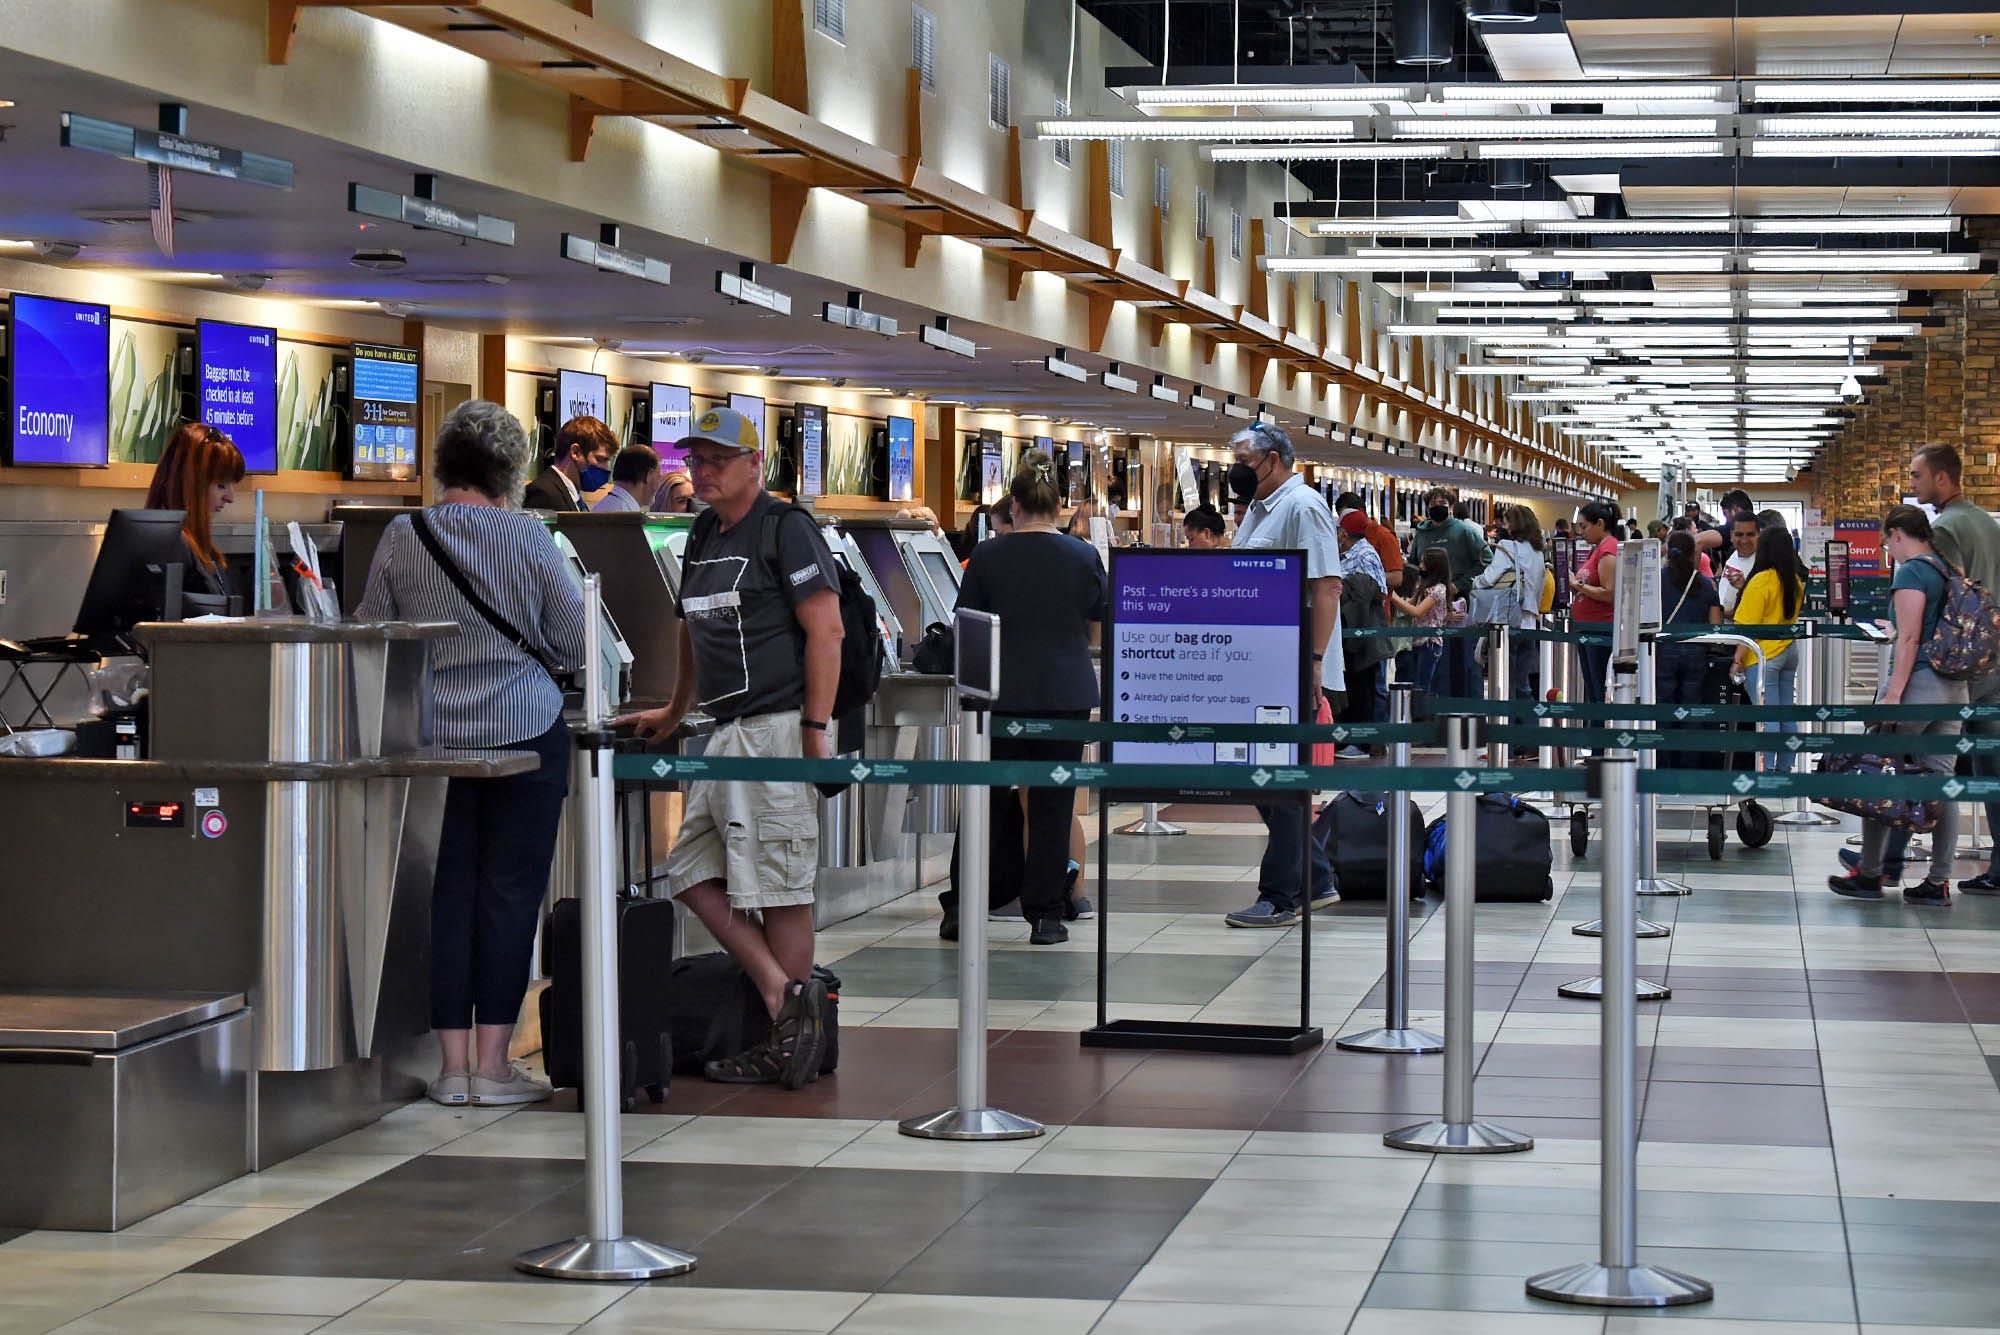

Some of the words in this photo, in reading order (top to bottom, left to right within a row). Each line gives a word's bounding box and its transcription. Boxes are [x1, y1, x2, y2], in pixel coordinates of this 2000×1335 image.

[75, 312, 95, 323] UNITED
[355, 347, 364, 356] Do
[364, 349, 373, 358] you
[374, 349, 387, 359] have
[392, 351, 406, 361] REAL
[205, 363, 228, 383] Baggage
[229, 367, 242, 382] must
[243, 366, 250, 382] be
[205, 385, 228, 402] checked
[228, 386, 234, 403] in
[235, 388, 241, 404] at
[241, 388, 254, 405] least
[19, 405, 74, 442] Economy
[205, 408, 214, 424] 45
[214, 408, 236, 424] minutes
[236, 409, 254, 426] before
[1233, 560, 1274, 568] UNITED
[1123, 585, 1146, 597] Psst
[1160, 585, 1198, 598] there's
[1201, 588, 1208, 598] a
[1211, 586, 1259, 599] shortcut
[1122, 600, 1144, 611] this
[1147, 601, 1171, 613] way
[1122, 631, 1145, 643] Use
[1149, 633, 1171, 644] our
[1174, 631, 1199, 646] bag
[1201, 631, 1233, 646] drop
[1121, 647, 1175, 660] shortcut
[1178, 649, 1207, 661] area
[1211, 647, 1220, 661] if
[1134, 671, 1157, 680] Have
[1159, 671, 1174, 681] the
[1176, 672, 1205, 681] United
[1207, 673, 1224, 683] app
[1134, 692, 1168, 703] Already
[1170, 693, 1190, 704] paid
[1191, 693, 1205, 703] for
[1207, 695, 1227, 704] your
[1230, 694, 1251, 704] bags
[1134, 713, 1149, 723] See
[1151, 713, 1168, 723] this
[1170, 713, 1189, 724] icon
